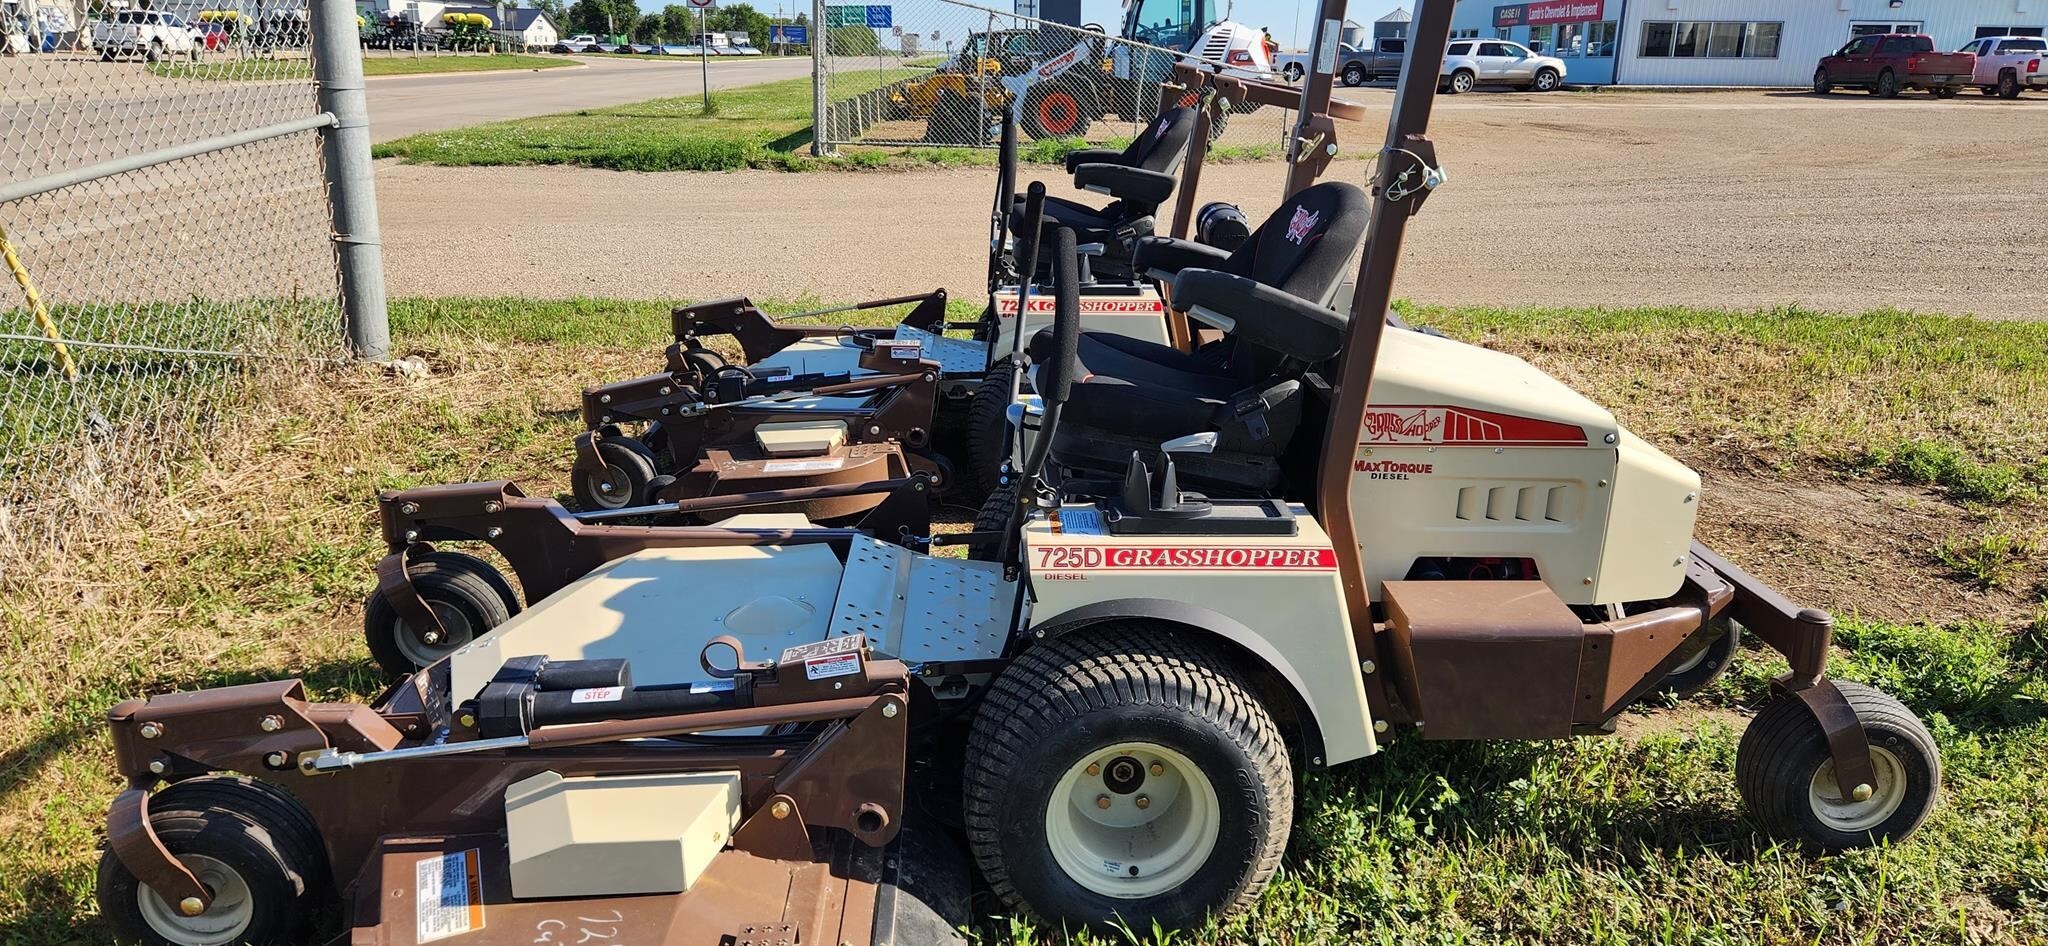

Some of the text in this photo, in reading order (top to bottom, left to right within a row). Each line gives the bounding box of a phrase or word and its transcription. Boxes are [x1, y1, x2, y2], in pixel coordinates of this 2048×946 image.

[1500, 8, 1515, 19] CASE
[1529, 8, 1544, 20] Lamb's
[1544, 6, 1566, 19] Chevrolet
[1571, 3, 1598, 18] Implement
[1001, 300, 1040, 312] 72K
[1371, 473, 1410, 481] DIESEL
[1037, 547, 1320, 568] 725D GRASSHOPPER
[1044, 573, 1088, 581] DIESEL
[584, 691, 610, 700] STEP
